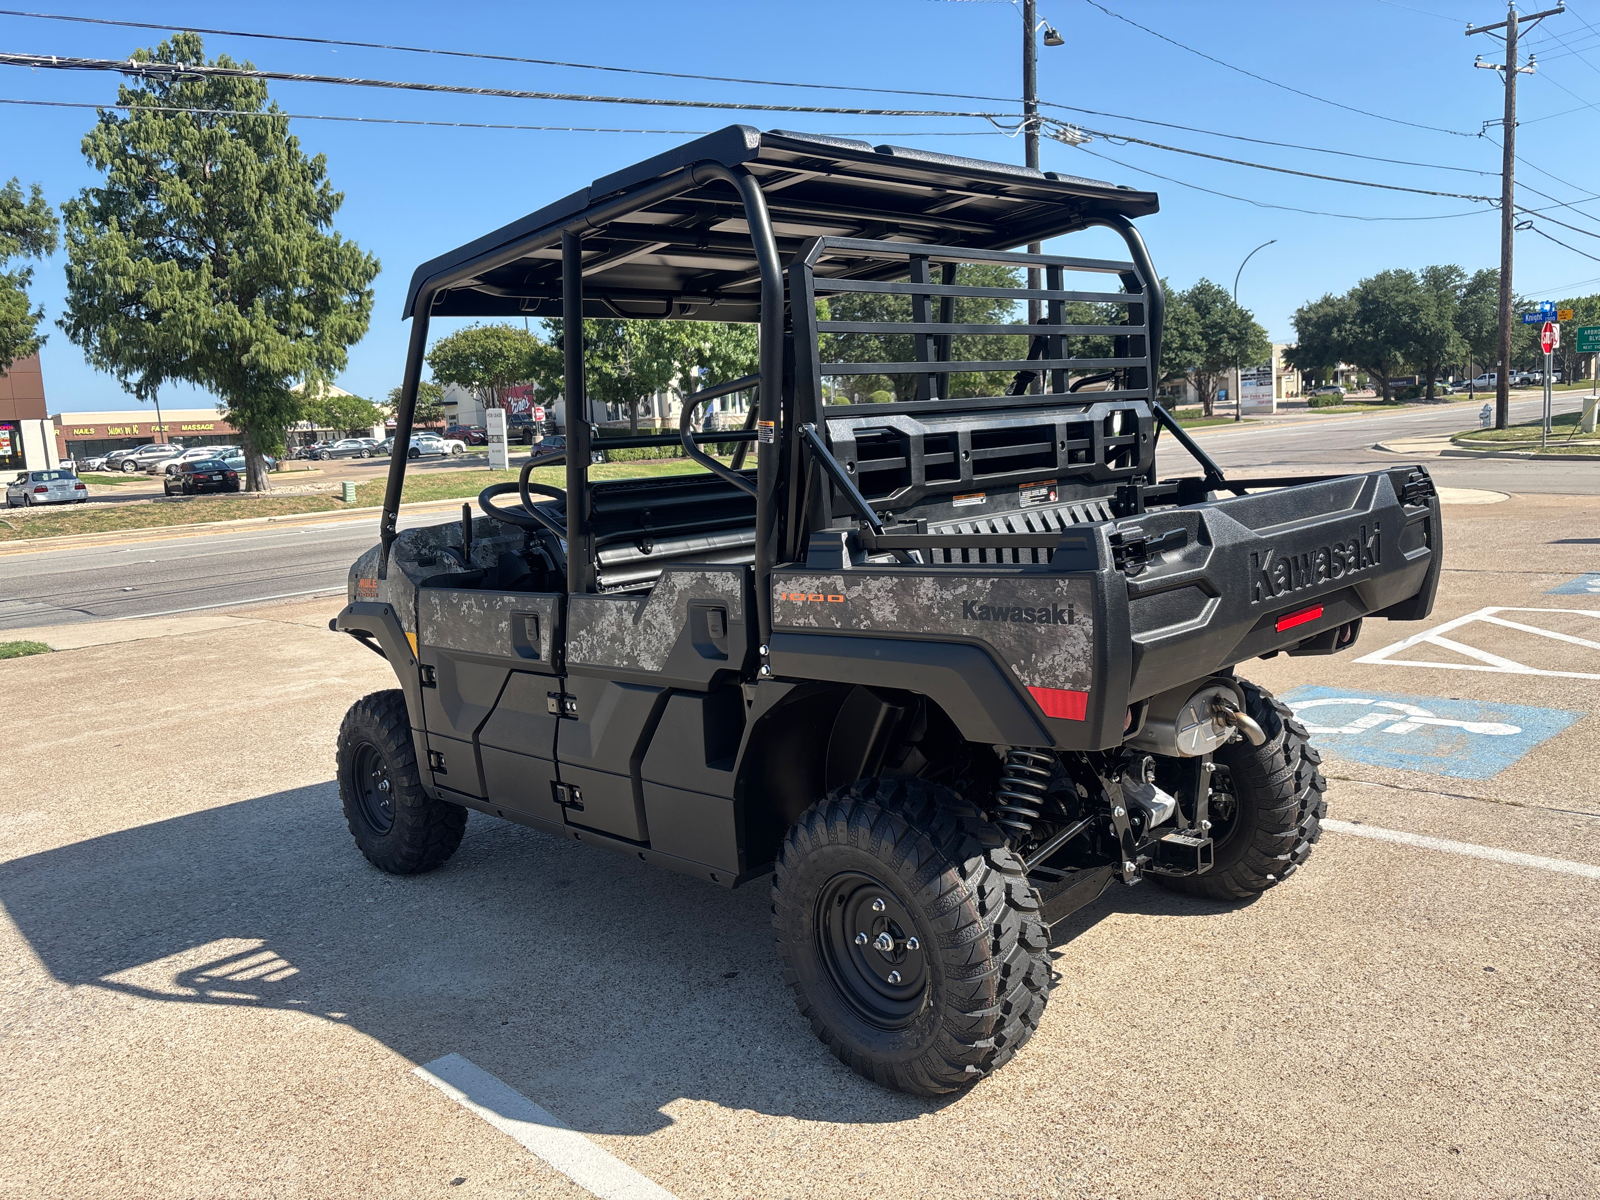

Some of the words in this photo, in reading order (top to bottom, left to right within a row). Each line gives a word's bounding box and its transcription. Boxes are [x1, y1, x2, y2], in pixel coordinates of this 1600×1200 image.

[1525, 313, 1543, 322] Knight
[1542, 332, 1554, 344] STOP
[1249, 521, 1381, 605] Kawasaki
[358, 578, 377, 588] MULE
[781, 593, 844, 603] 1000
[962, 599, 1075, 625] Kawasaki
